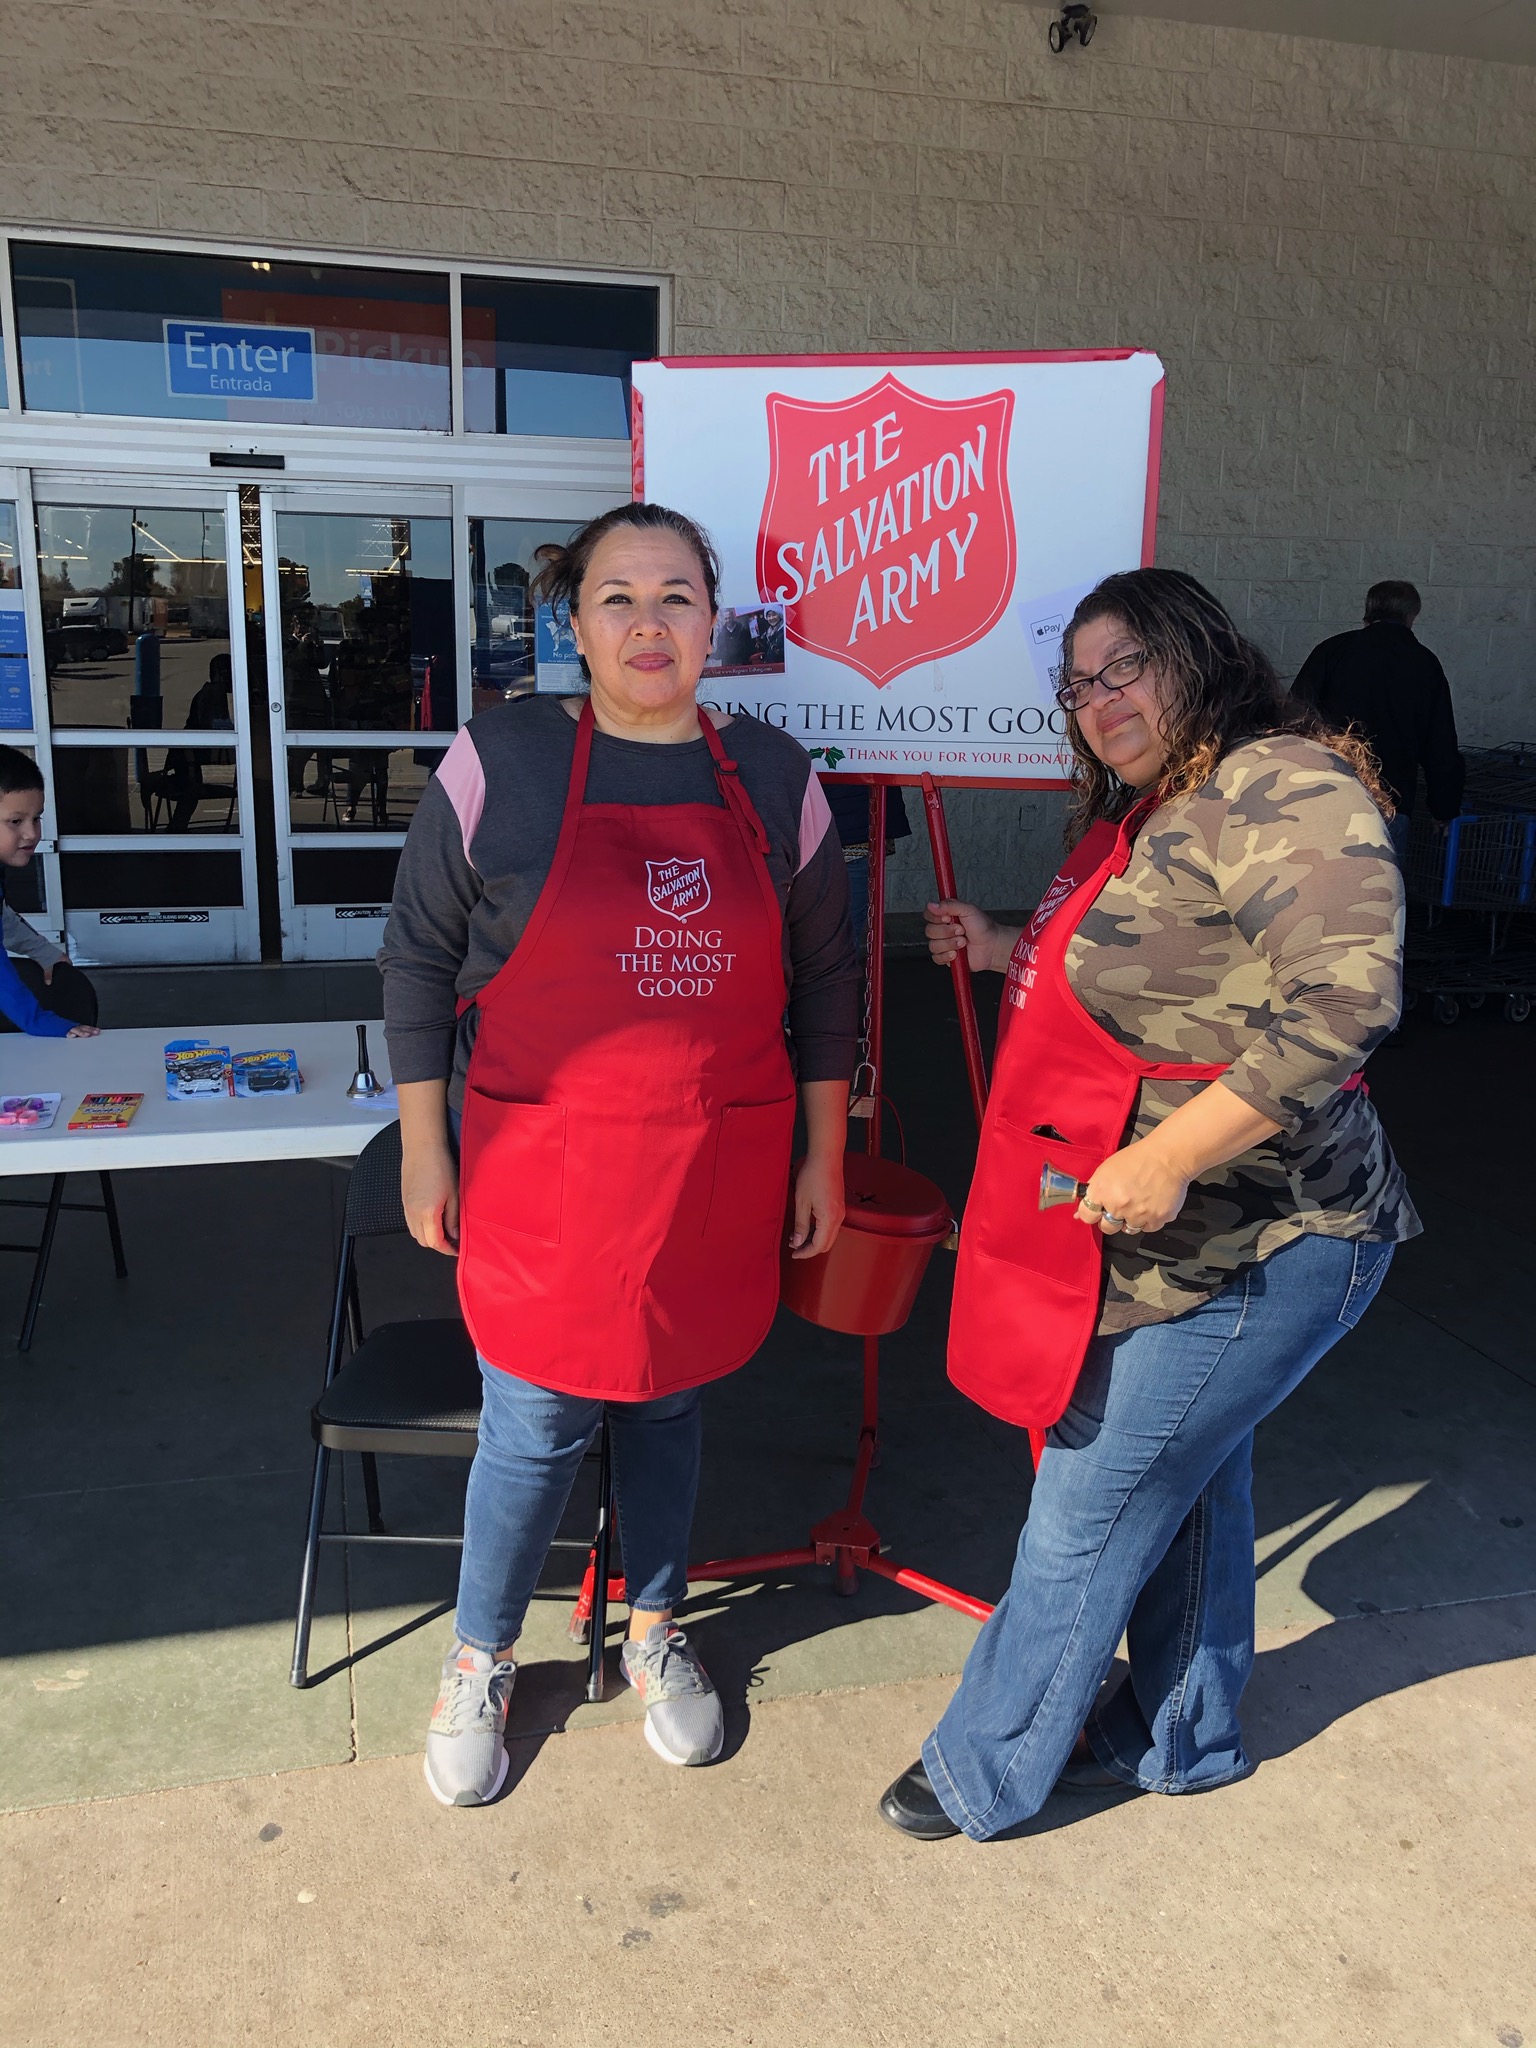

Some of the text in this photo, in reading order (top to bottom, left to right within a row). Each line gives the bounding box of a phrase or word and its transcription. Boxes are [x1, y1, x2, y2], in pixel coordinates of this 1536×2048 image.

[184, 331, 295, 374] Enter
[210, 375, 272, 392] Entrada
[335, 401, 375, 423] Toys
[380, 405, 398, 422] to
[404, 404, 437, 423] TVs
[808, 411, 903, 507] THE
[775, 424, 986, 605] SALVATION
[846, 512, 978, 647] ARMY
[1043, 623, 1061, 634] Pay
[797, 703, 865, 731] THE
[875, 704, 978, 733] MOST
[988, 706, 1067, 735] GOO
[903, 750, 933, 762] YOU
[938, 751, 967, 763] FOR
[971, 752, 1013, 764] YOUR
[653, 866, 701, 902] SALVATION
[658, 865, 680, 882] THE
[671, 882, 701, 911] ARMY
[634, 926, 722, 949] DOING
[615, 953, 736, 973] THE MOST
